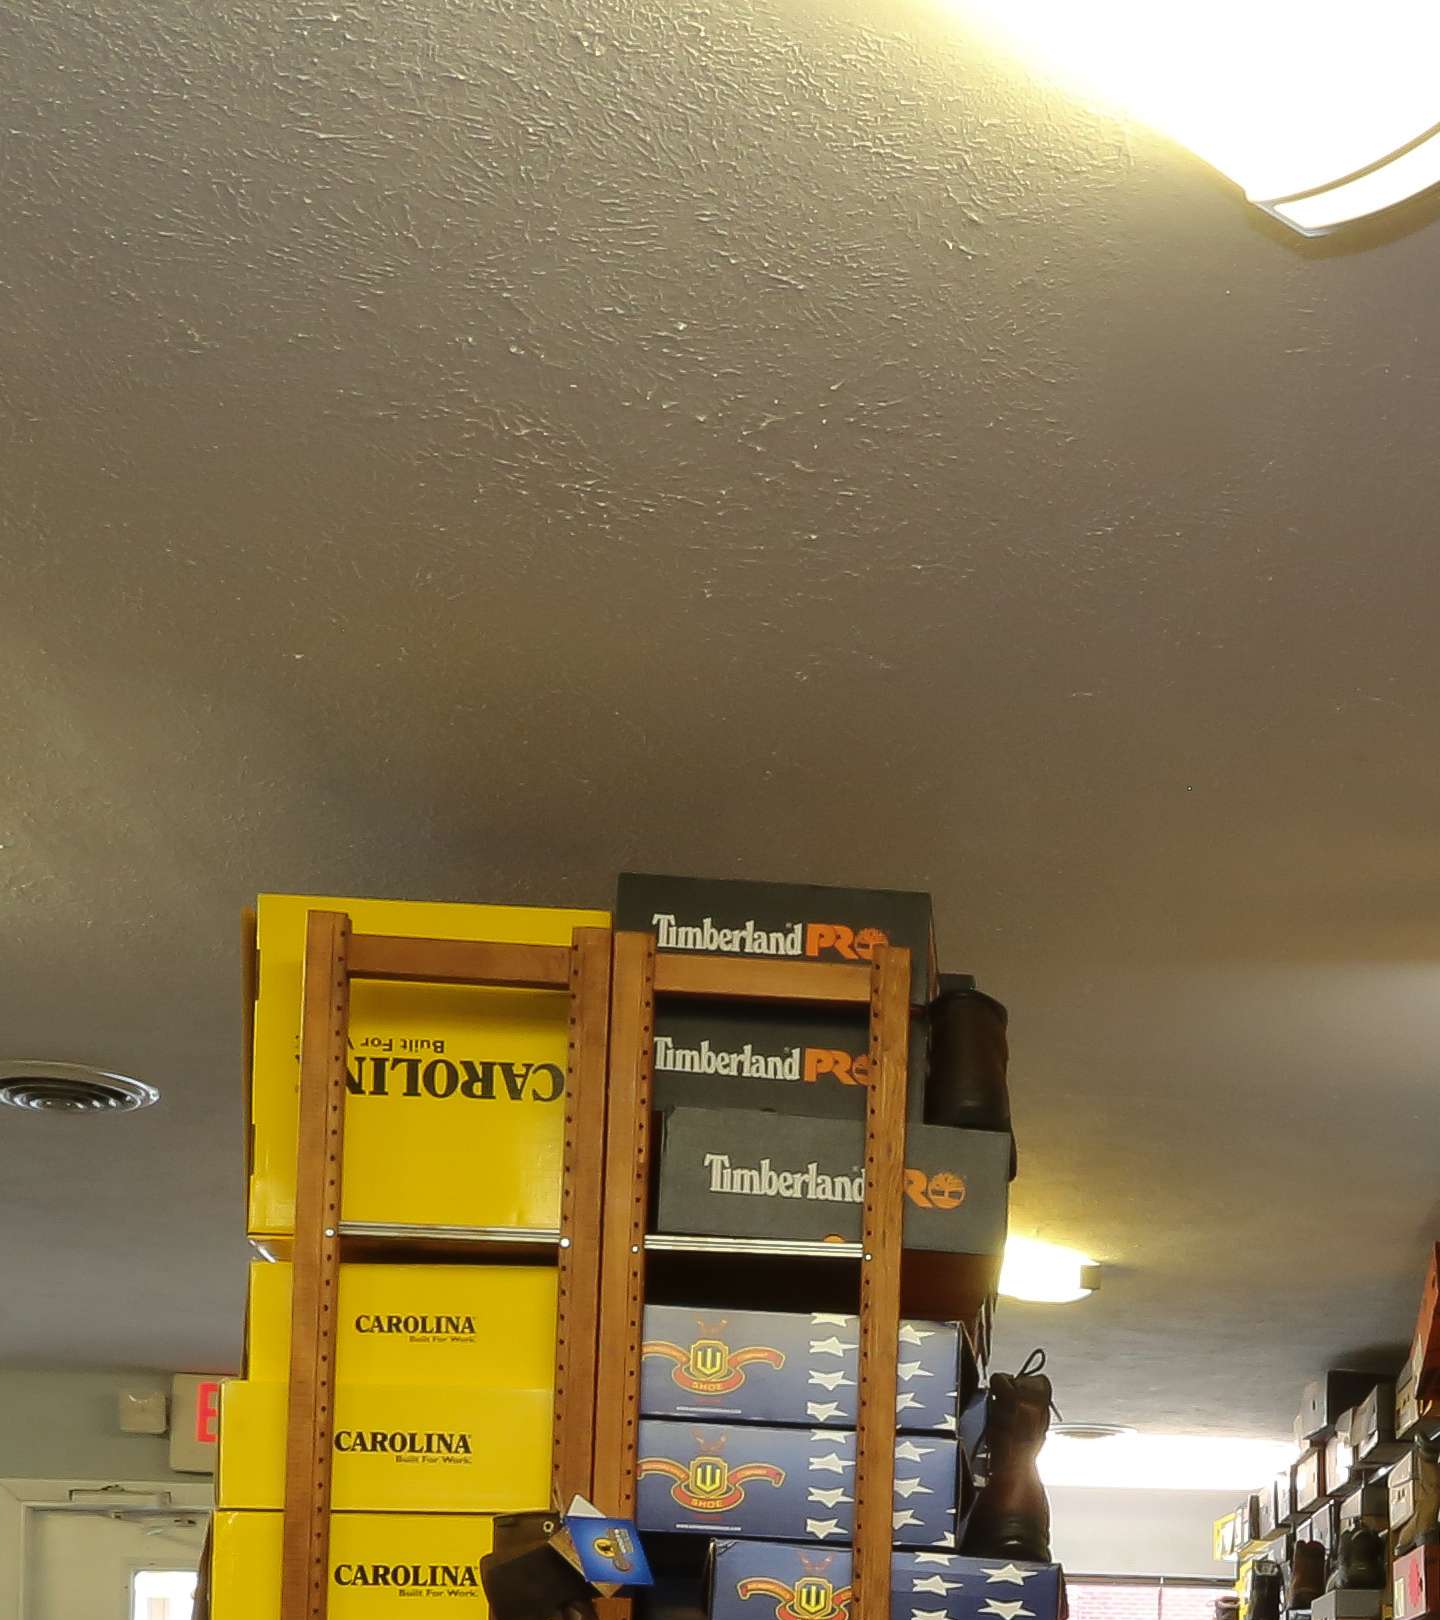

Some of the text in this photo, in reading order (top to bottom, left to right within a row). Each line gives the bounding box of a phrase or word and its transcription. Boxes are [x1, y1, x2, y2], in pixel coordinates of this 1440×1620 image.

[652, 914, 802, 955] Timberland
[361, 1036, 444, 1053] Built For
[654, 1037, 800, 1080] Timberland
[346, 1056, 565, 1101] CAROLIN
[704, 1154, 966, 1209] Timberland RO
[355, 1315, 476, 1334] CAROLINA
[334, 1431, 472, 1454] CAROLINA
[334, 1565, 478, 1587] CAROLINA
